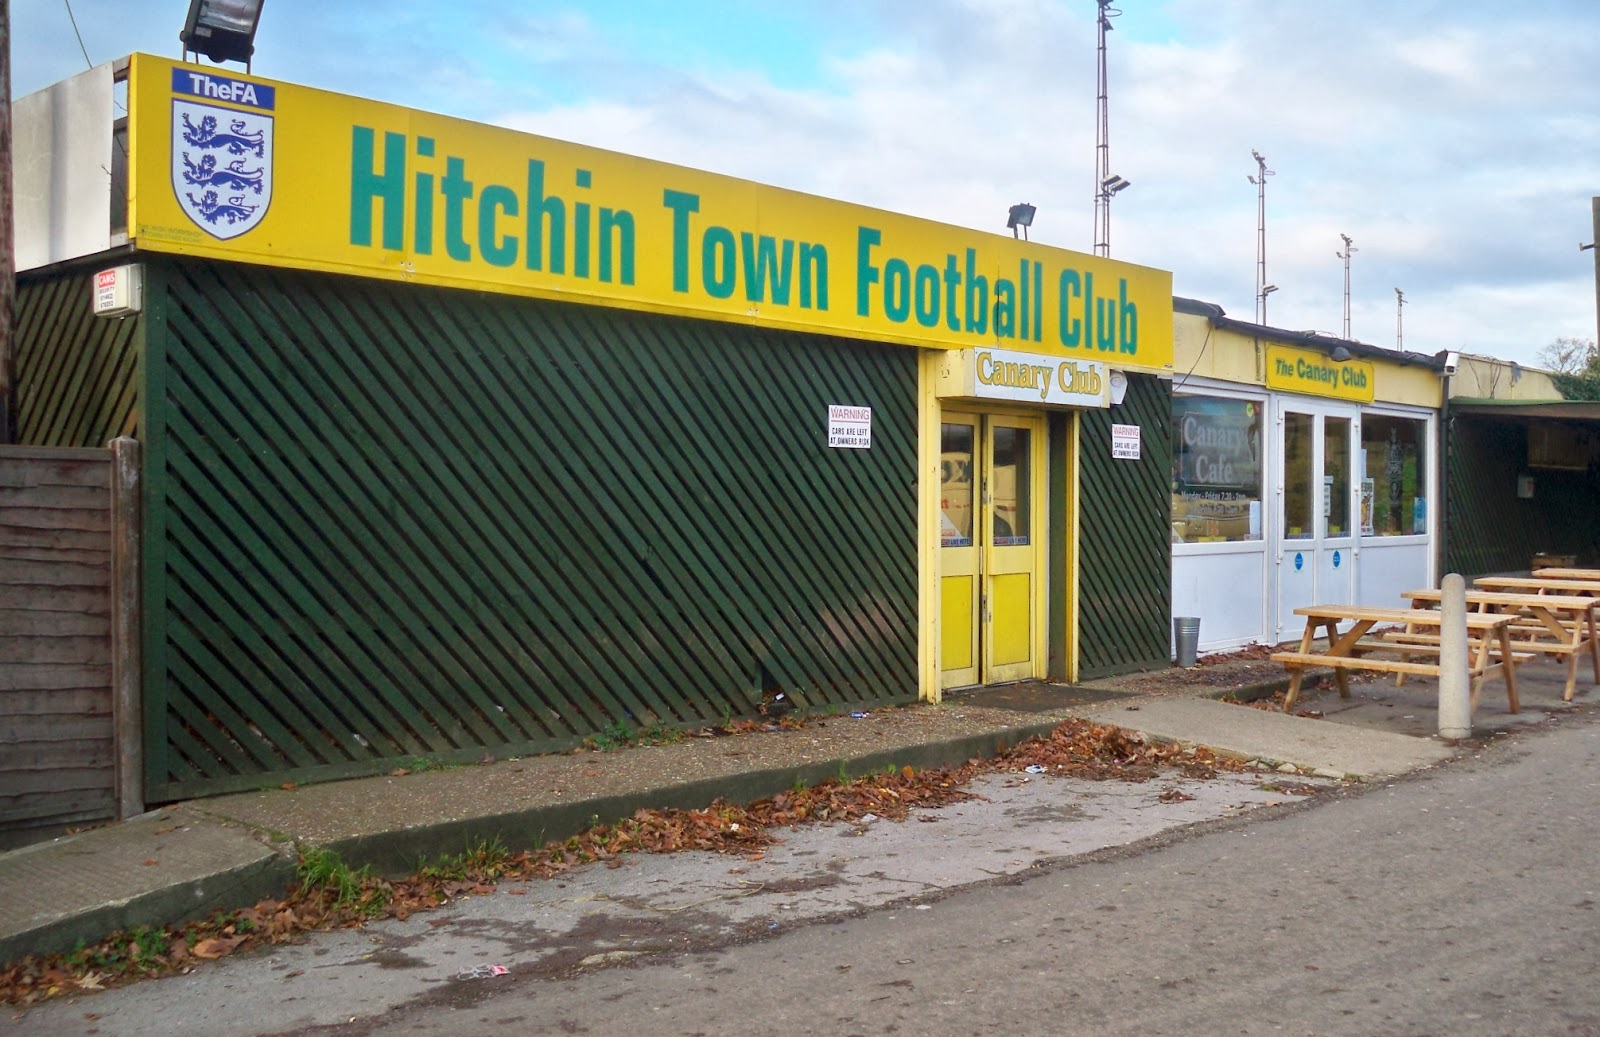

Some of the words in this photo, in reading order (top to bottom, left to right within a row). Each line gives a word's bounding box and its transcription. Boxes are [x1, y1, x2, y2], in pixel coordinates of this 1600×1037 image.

[189, 73, 258, 105] TheFA
[350, 124, 635, 286] Hitchin
[663, 188, 829, 311] Town
[856, 226, 1042, 342] Football
[1059, 268, 1138, 356] Club
[99, 272, 115, 285] CAMS
[976, 351, 1053, 400] Canary
[1057, 361, 1102, 395] Club
[1276, 358, 1294, 376] The
[1296, 358, 1339, 389] Canary
[1341, 366, 1367, 389] Club
[831, 408, 870, 420] WARNING
[830, 437, 836, 445] AT
[837, 437, 858, 446] OWNERS
[859, 438, 870, 446] RISK
[832, 427, 845, 436] CARS
[846, 428, 856, 436] ARE
[856, 428, 868, 436] LEFT
[1113, 426, 1139, 437] WARNING
[1184, 416, 1246, 458] Canary
[1196, 453, 1233, 484] Cafe
